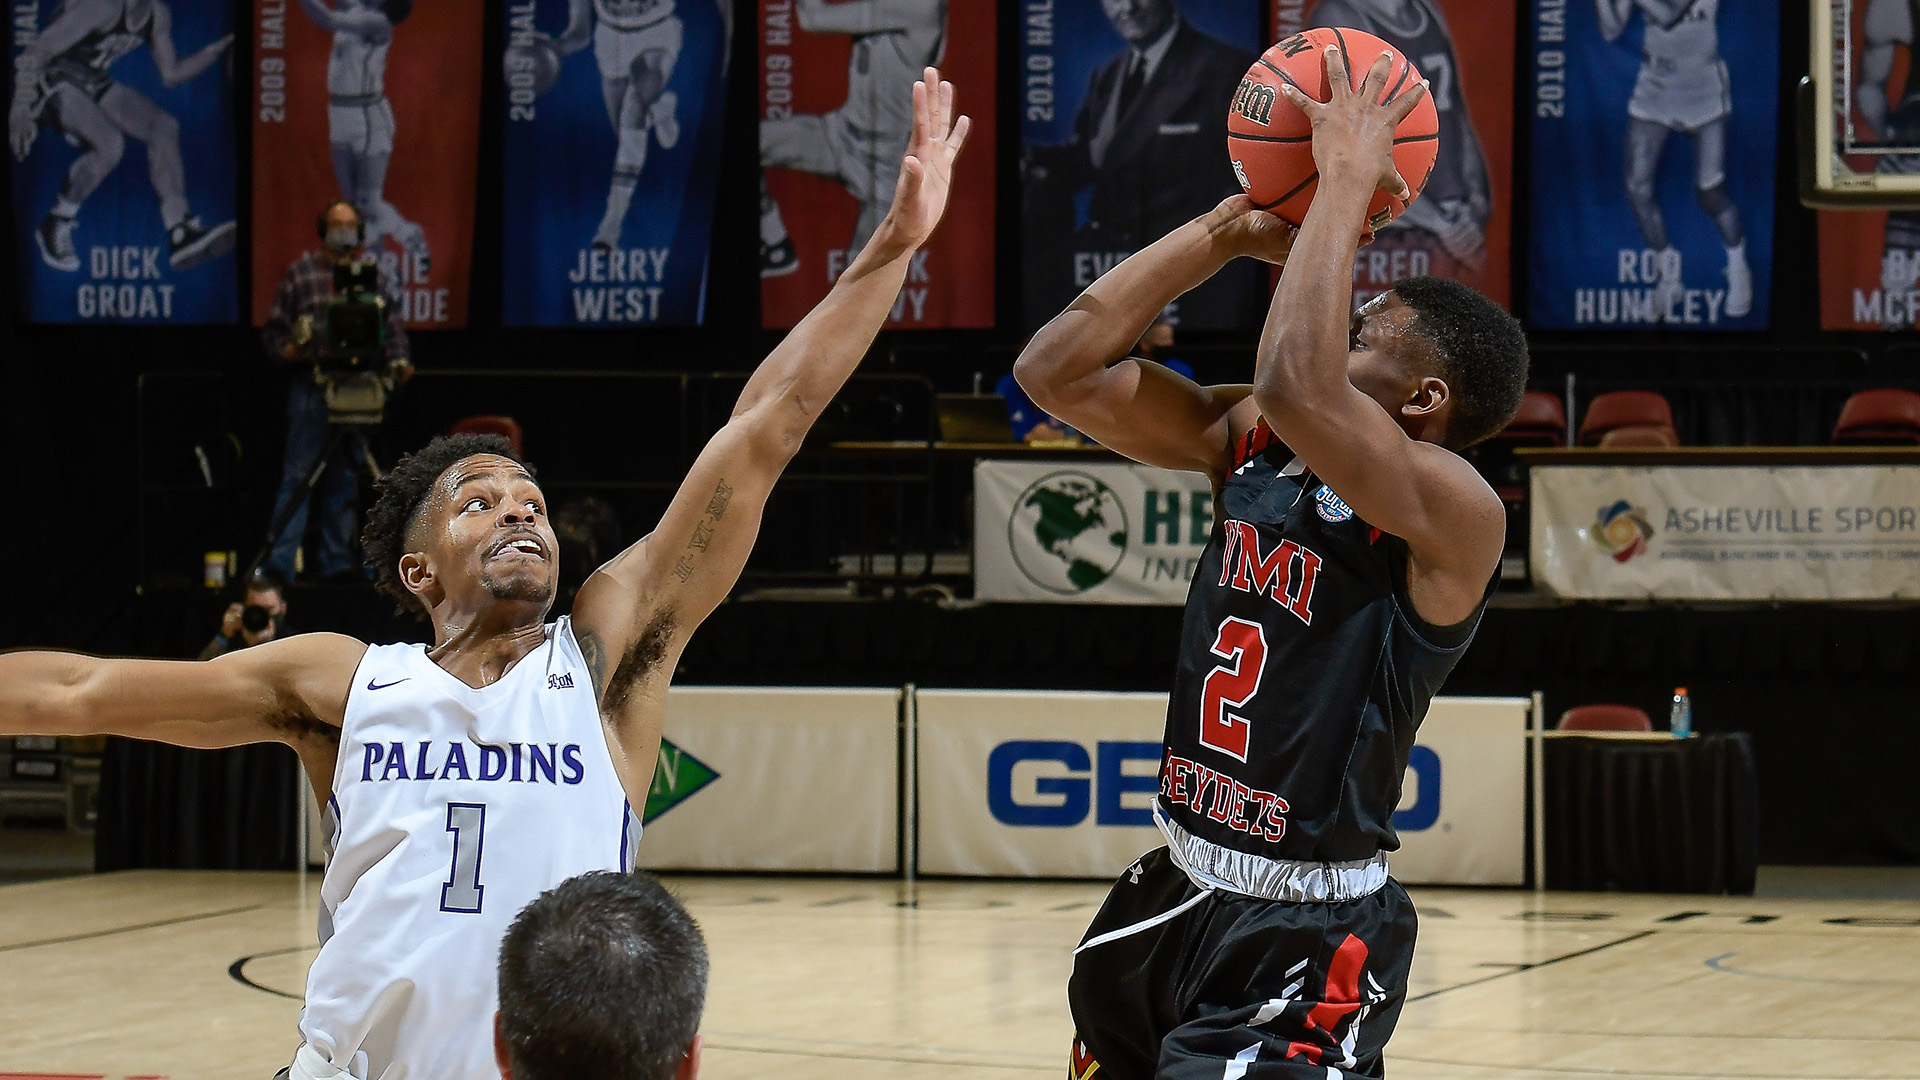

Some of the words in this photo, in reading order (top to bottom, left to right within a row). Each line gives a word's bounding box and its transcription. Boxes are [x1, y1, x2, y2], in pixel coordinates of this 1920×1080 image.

[260, 57, 285, 122] 2009
[509, 56, 536, 121] 2009
[765, 54, 792, 120] 2009
[1026, 54, 1054, 121] 2010
[1537, 51, 1565, 118] 2010
[91, 246, 161, 280] DICK
[568, 248, 669, 283] JERRY
[78, 285, 176, 319] GROAT
[572, 288, 664, 322] WEST
[1664, 507, 1823, 534] ASHEVILLE
[1199, 615, 1269, 764] 2
[360, 740, 585, 786] PALADINS
[439, 801, 486, 914] 1
